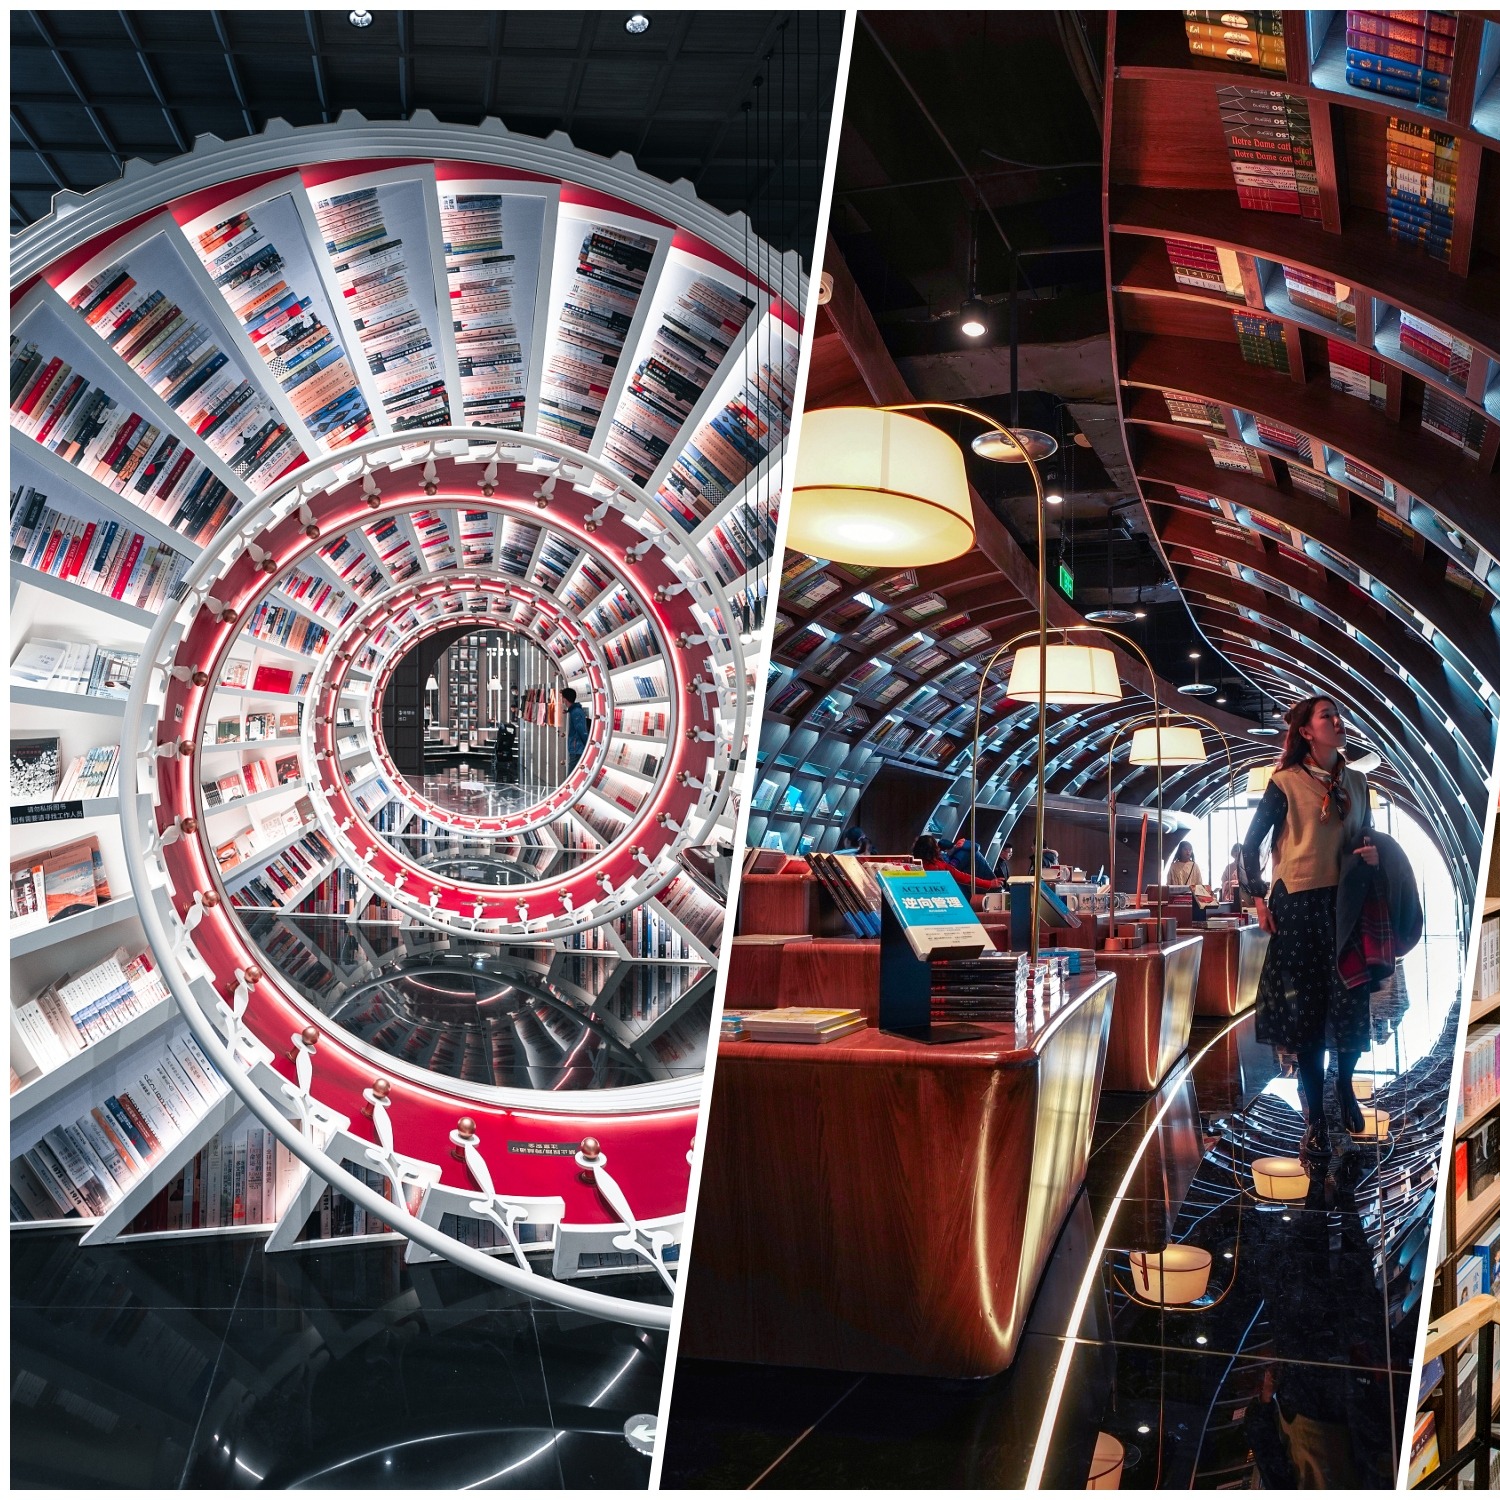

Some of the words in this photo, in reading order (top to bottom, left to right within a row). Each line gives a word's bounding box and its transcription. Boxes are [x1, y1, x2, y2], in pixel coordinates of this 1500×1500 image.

[1231, 136, 1251, 147] Notre
[1254, 138, 1275, 149] Dame
[1234, 150, 1254, 159] Notre
[1256, 152, 1277, 161] Dame
[1219, 461, 1248, 470] ROCKY
[12, 811, 83, 824] 如有需要请寻找工作人员
[923, 885, 946, 893] LIKE
[901, 896, 963, 909] 逆向管理
[69, 1190, 82, 1205] 1914
